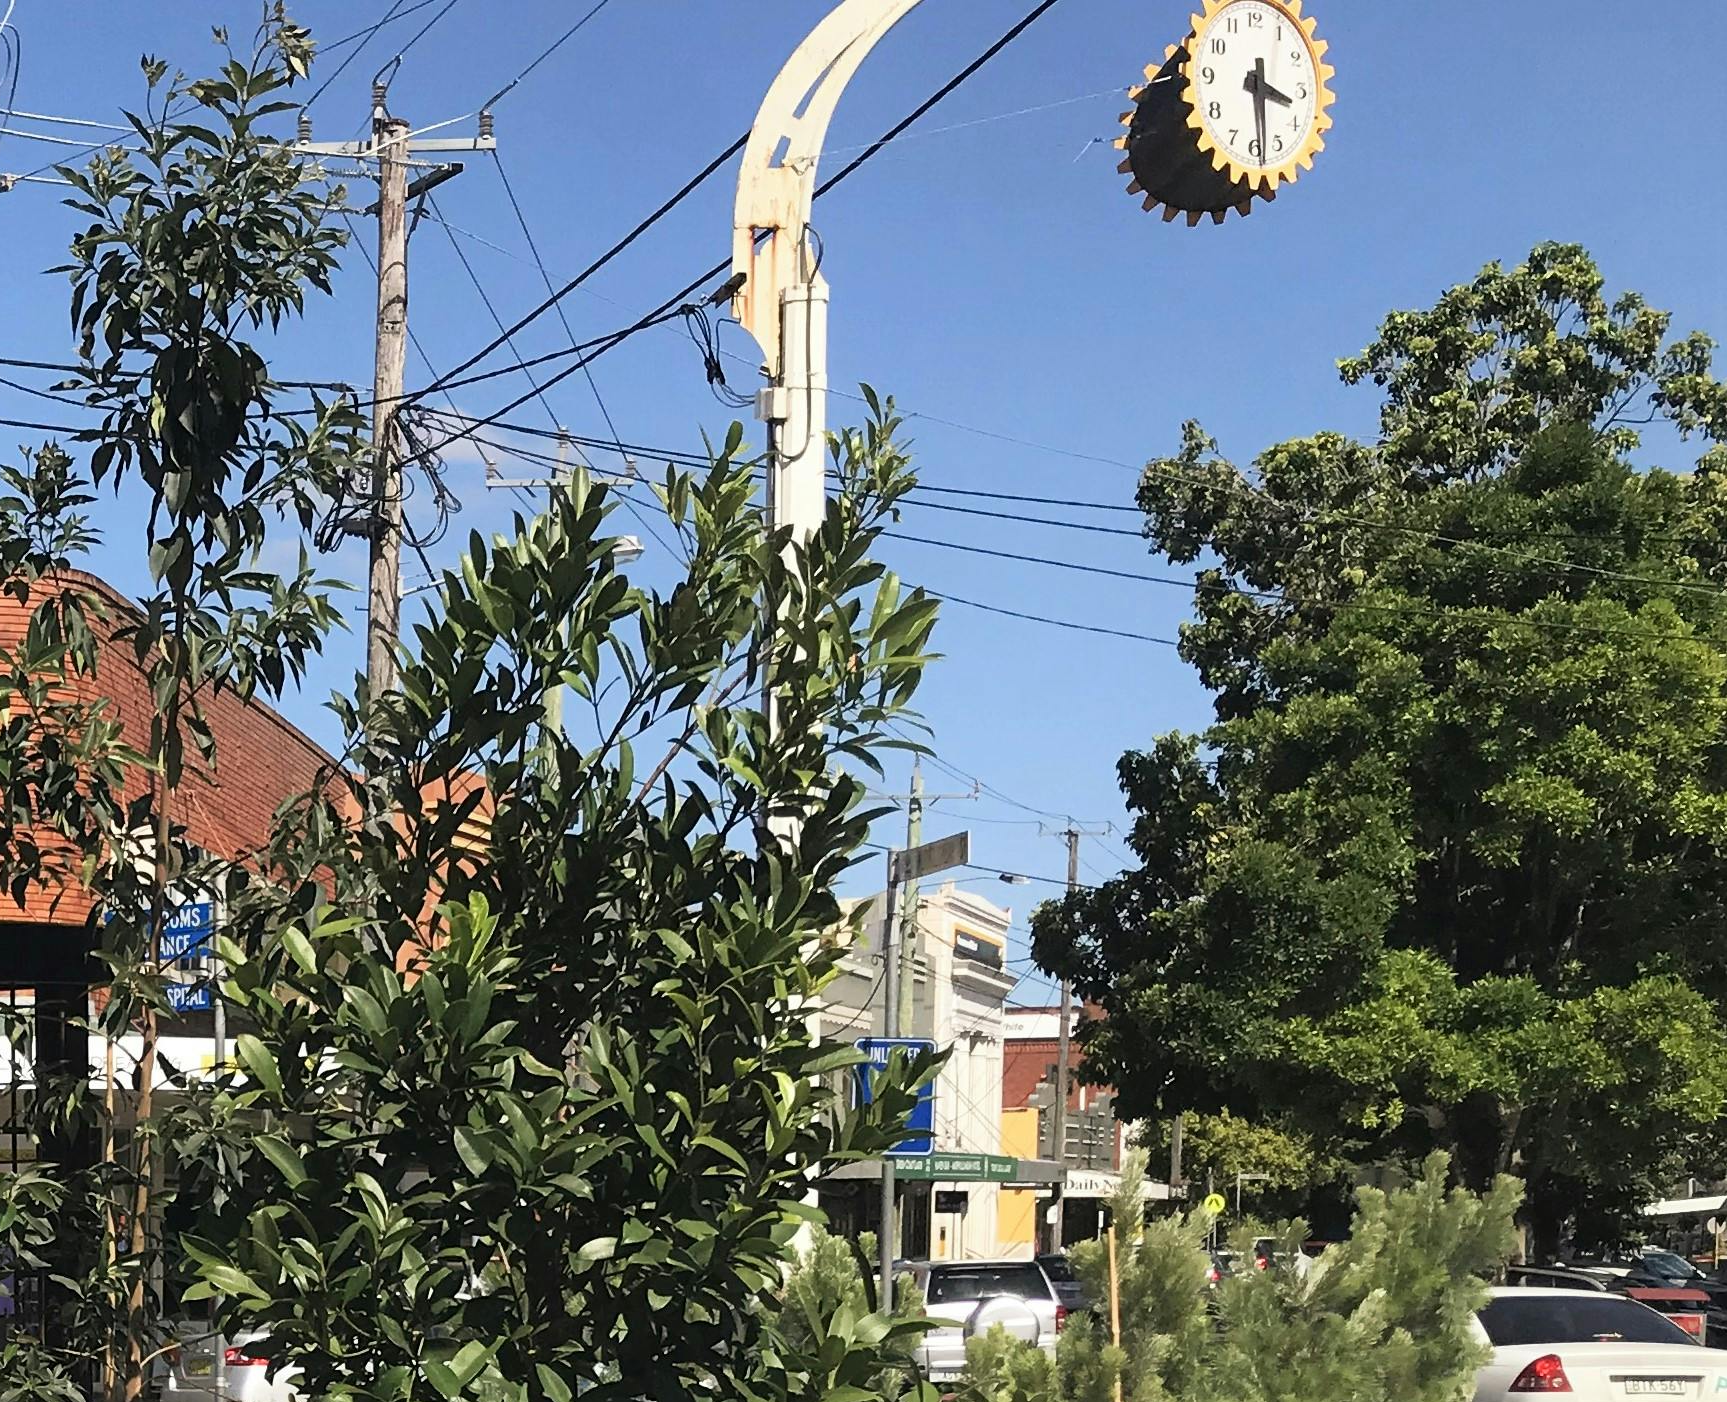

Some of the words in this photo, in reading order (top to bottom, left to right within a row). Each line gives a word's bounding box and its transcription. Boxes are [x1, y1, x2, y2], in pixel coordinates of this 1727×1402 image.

[1226, 18, 1238, 34] 11
[1247, 12, 1263, 28] 12
[1275, 26, 1282, 41] 1
[1211, 39, 1226, 55] 10
[1291, 51, 1301, 67] 2
[1202, 67, 1215, 84] 9
[1295, 83, 1307, 99] 3
[1209, 102, 1221, 119] 8
[1286, 115, 1300, 132] 4
[1228, 129, 1239, 146] 7
[1272, 135, 1283, 151] 5
[1248, 139, 1261, 157] 6
